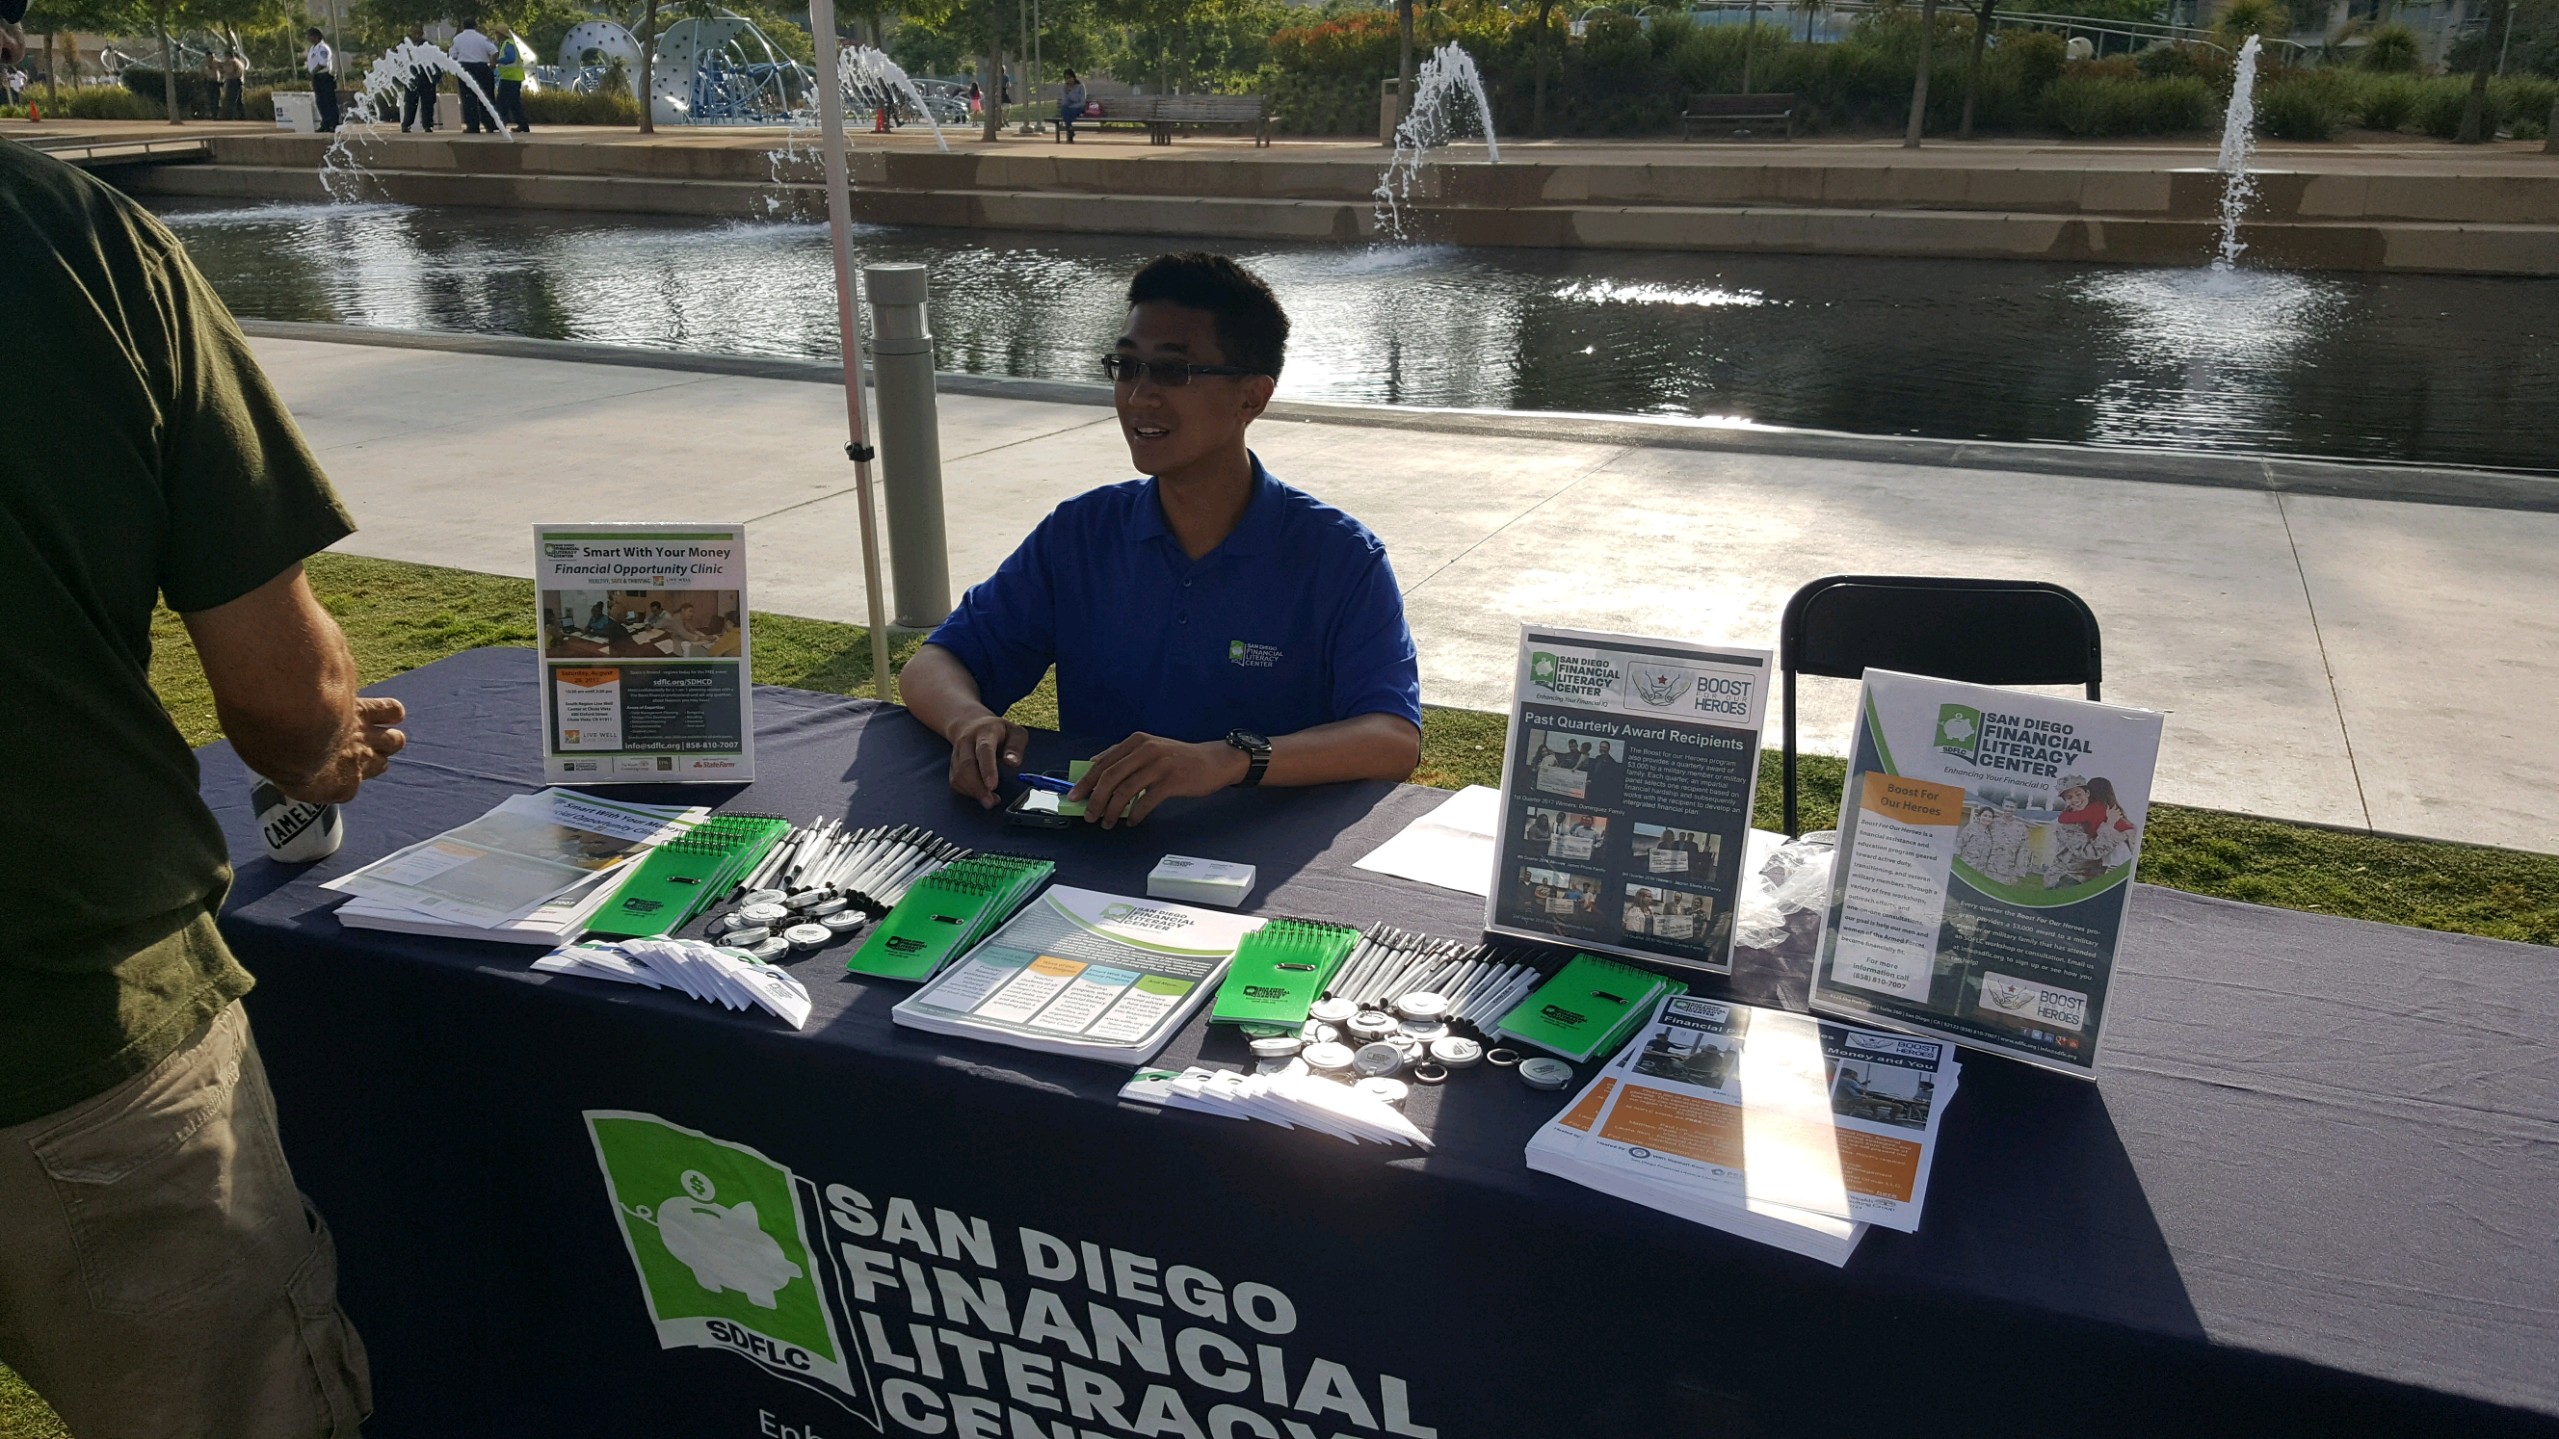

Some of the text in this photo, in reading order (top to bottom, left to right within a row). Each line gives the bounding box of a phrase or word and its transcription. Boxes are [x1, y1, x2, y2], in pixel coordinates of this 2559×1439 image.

[584, 547, 731, 560] Smart With Your Money
[555, 563, 723, 576] Financial Opportunity Clinic
[1246, 654, 1279, 662] LITERACY
[1247, 649, 1283, 657] FINANCIAL
[1560, 656, 1609, 668] SAN DIEGO
[1559, 665, 1620, 679] FINANCIAL
[1558, 674, 1613, 688] LITERACY
[1698, 677, 1752, 696] BOOST
[1557, 684, 1601, 696] CENTER
[1536, 693, 1564, 702] Enhancing
[1577, 698, 1601, 706] Financial
[1695, 697, 1747, 715] HEROES
[1525, 712, 1744, 751] Past Quarterly Award Recipients
[1986, 713, 2074, 735] SAN DIEGO
[625, 742, 680, 750] info@sdflc.org
[1984, 725, 2093, 754] FINANCIAL
[1685, 755, 1708, 763] Heroes
[1709, 758, 1736, 767] program
[1982, 739, 2078, 766] LITERACY
[1643, 757, 1669, 765] provides
[1677, 762, 1704, 771] quarterly
[1706, 765, 1726, 773] award
[1979, 753, 2058, 778] CENTER
[1664, 766, 1688, 776] military
[1687, 771, 1713, 779] member
[1723, 776, 1746, 784] military
[1944, 766, 2049, 791] Enhancing Your Financial IQ
[1644, 779, 1666, 788] selects
[1681, 784, 1708, 793] recipient
[1710, 788, 1729, 797] based
[1888, 784, 1939, 801] Boost For
[1651, 788, 1679, 797] hardship
[1694, 794, 1736, 806] subsequently
[1881, 797, 1941, 816] Our Heroes
[564, 803, 596, 814] Smart
[596, 810, 620, 819] With
[622, 815, 645, 824] Your
[645, 821, 683, 833] Money
[1860, 830, 1885, 840] financial
[1886, 836, 1916, 846] assistance
[1901, 827, 1921, 835] Heroes
[1129, 916, 1184, 928] LITERACY
[1132, 912, 1195, 926] FINANCIAL
[1159, 911, 1188, 919] DIEGO
[1856, 917, 1869, 925] goal
[1876, 921, 1889, 930] help
[1980, 905, 2003, 914] quarter
[2017, 913, 2035, 921] Boost
[2063, 922, 2085, 932] Heroes
[1124, 921, 1171, 931] CENTER
[1843, 926, 1864, 935] women
[1884, 935, 1905, 944] Armed
[1905, 939, 1925, 948] Forces
[2018, 936, 2038, 946] family
[2040, 940, 2052, 949] that
[2067, 948, 2096, 958] attended
[1853, 963, 1897, 979] information
[1880, 962, 1898, 970] more
[1853, 972, 1906, 990] (858) 810-7007
[2040, 991, 2085, 1011] BOOST
[1664, 1015, 1722, 1033] Financial
[2038, 1007, 2080, 1025] HEROES
[1896, 1048, 1935, 1058] HEROES
[1898, 1041, 1937, 1051] BOOST
[1828, 1048, 1934, 1070] Money and You
[826, 1184, 1298, 1335] SAN DIEGO
[706, 1321, 811, 1372] SDFLC
[841, 1242, 1438, 1439] FINANCIAL
